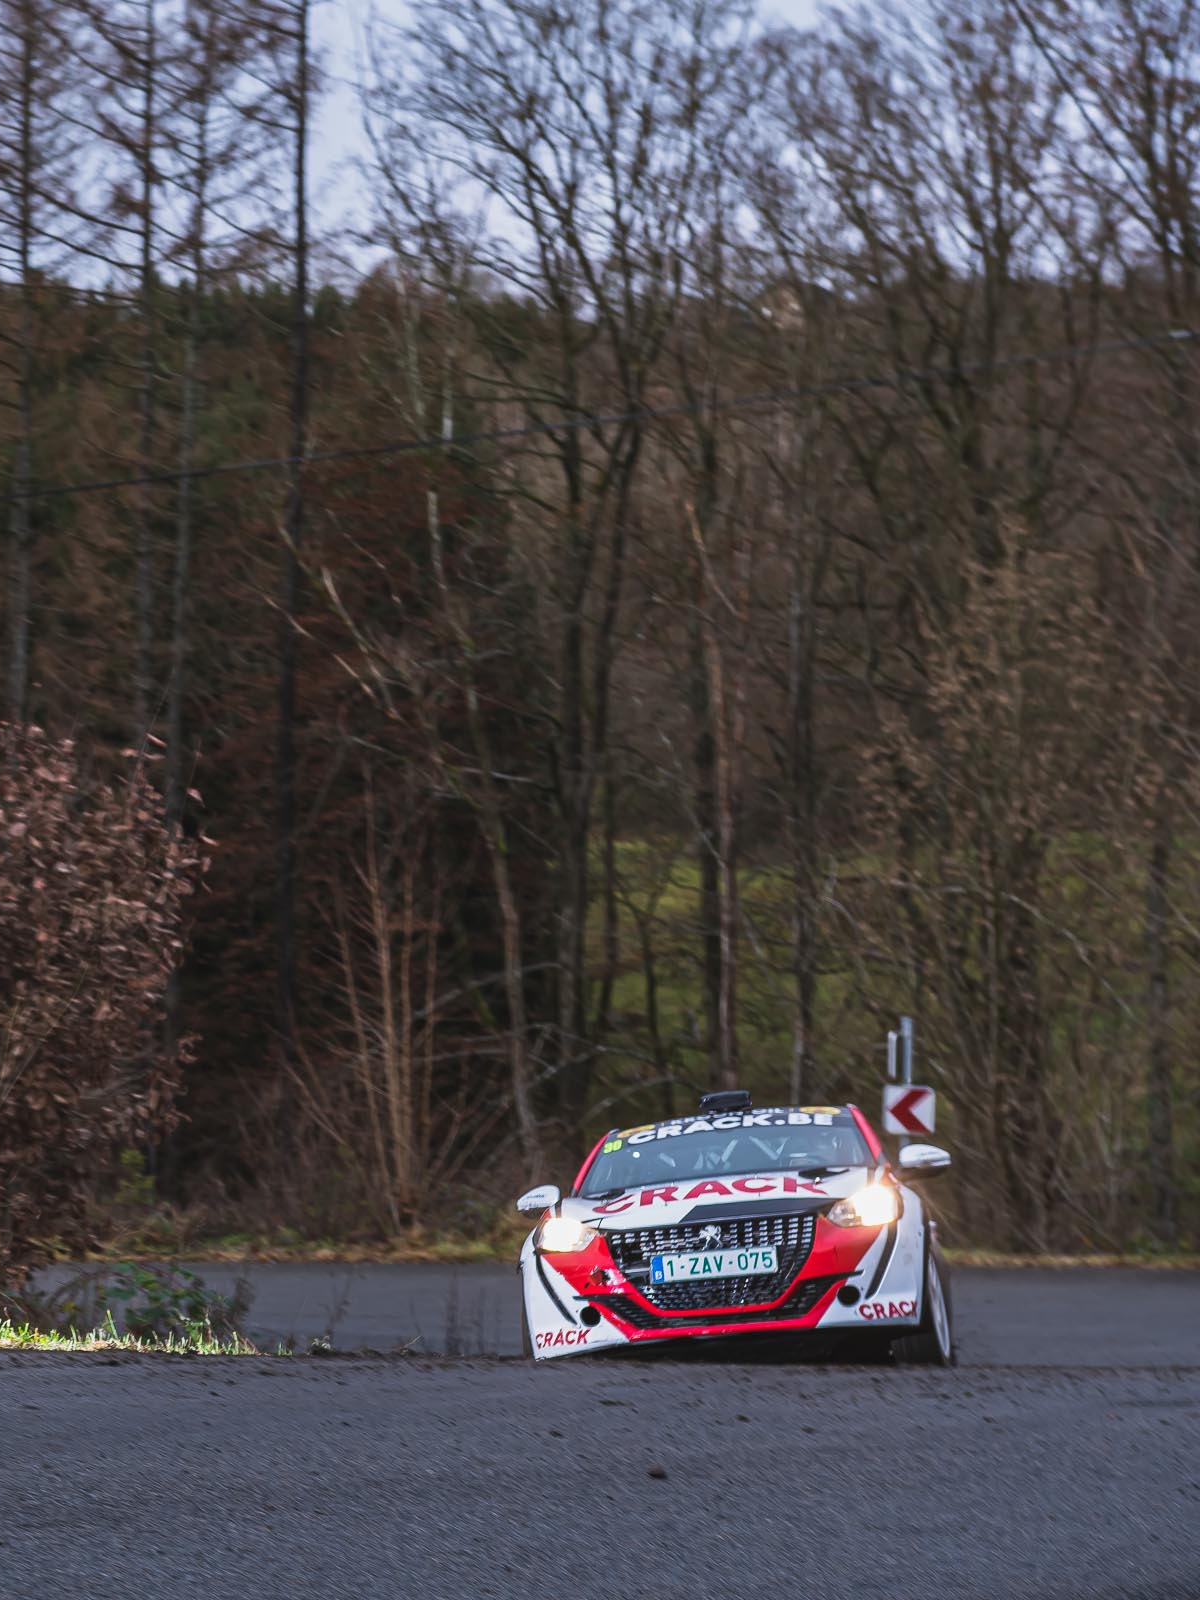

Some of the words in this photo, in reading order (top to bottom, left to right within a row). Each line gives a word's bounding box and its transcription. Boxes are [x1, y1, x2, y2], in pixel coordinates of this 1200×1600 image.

[627, 1112, 834, 1145] CRACK.BE
[592, 1176, 828, 1214] CRACK
[666, 1251, 774, 1277] 1-ZAV-075
[859, 1300, 918, 1321] CRACK
[535, 1328, 592, 1350] CRACK
